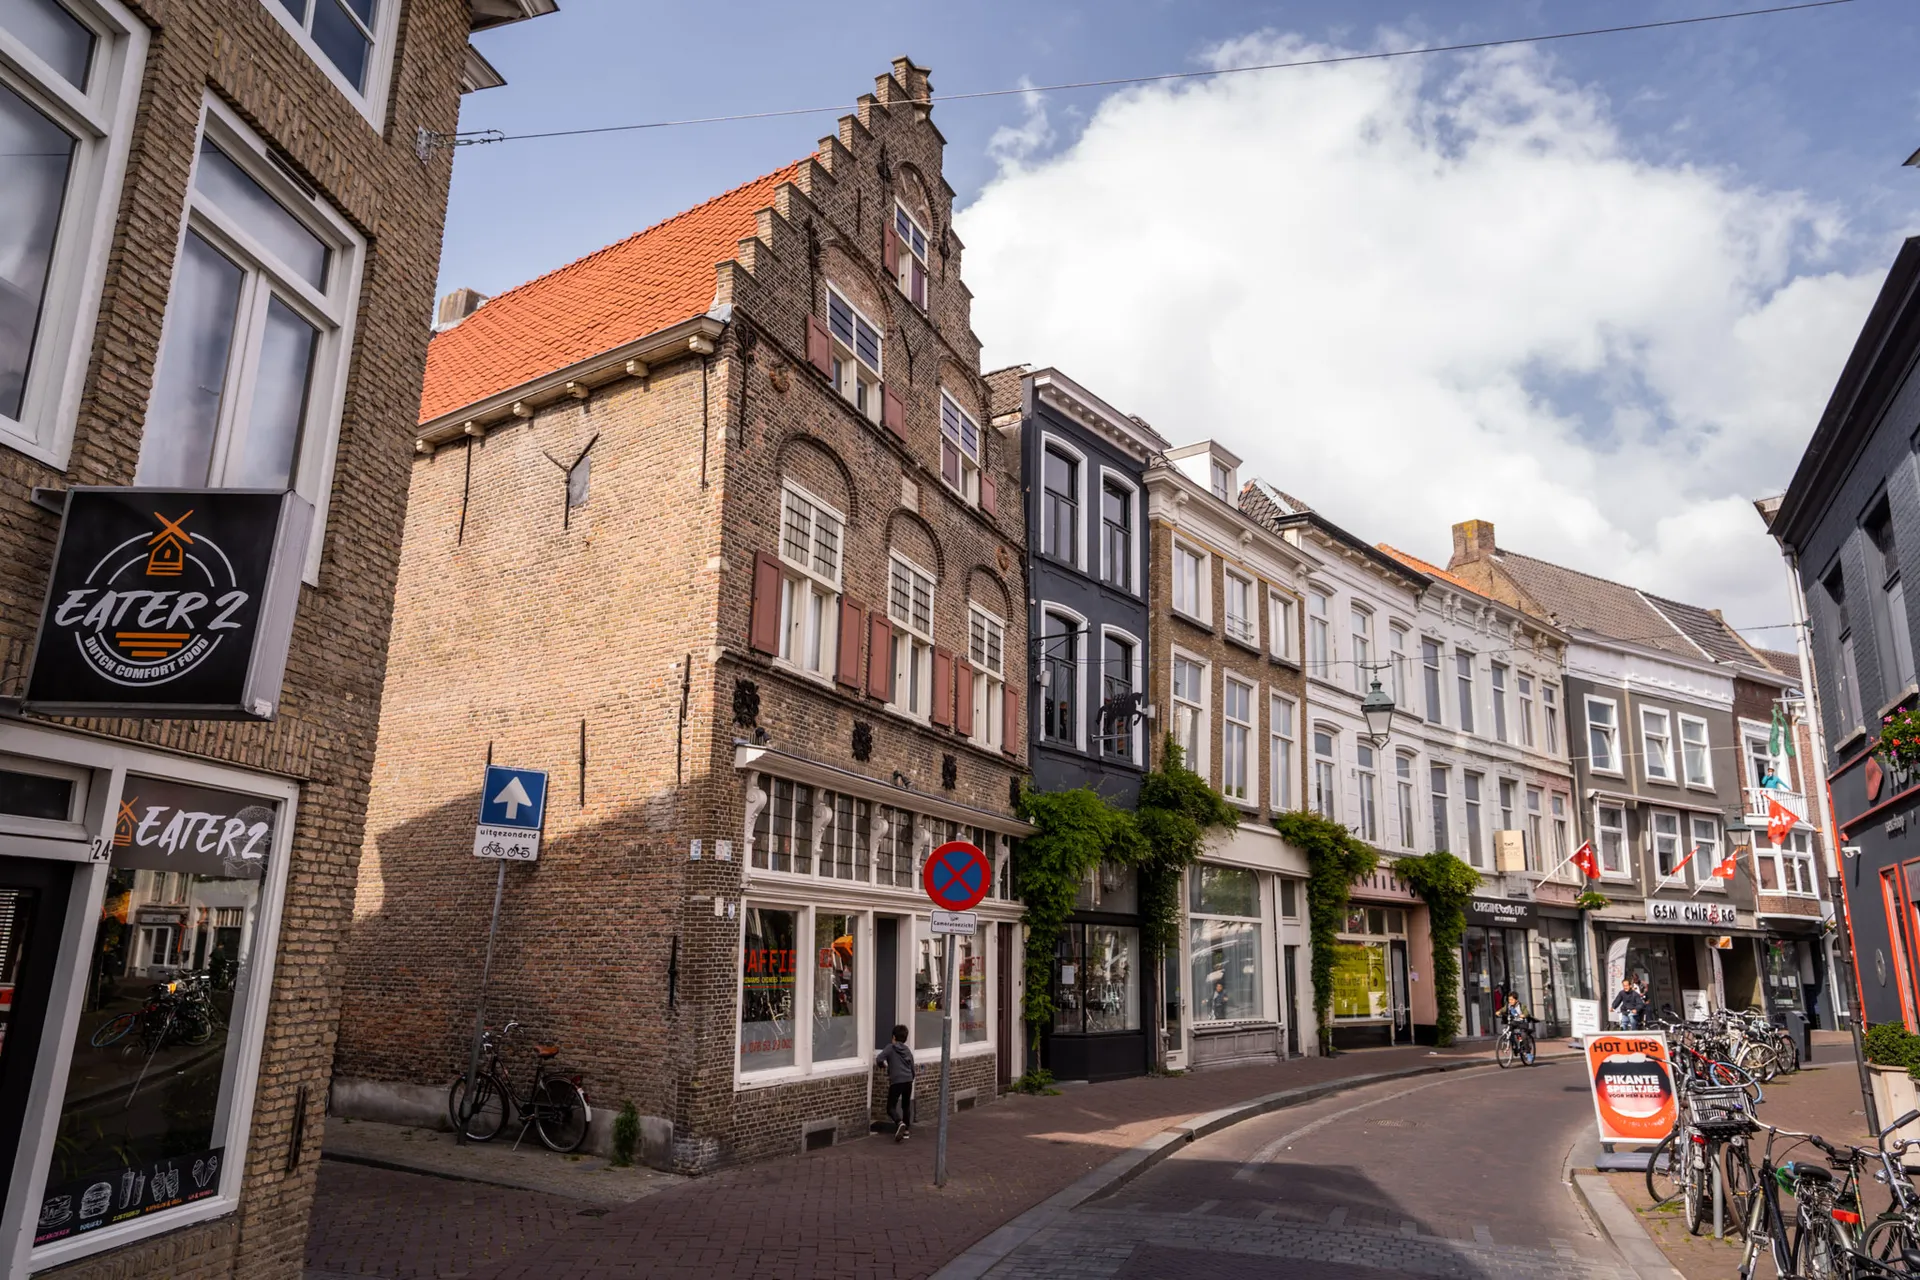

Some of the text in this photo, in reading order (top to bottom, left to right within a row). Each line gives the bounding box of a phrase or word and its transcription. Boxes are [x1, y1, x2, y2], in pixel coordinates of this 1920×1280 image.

[54, 588, 249, 633] EATER 2
[84, 635, 209, 679] DUTCH COMFORT FOOD
[480, 829, 537, 839] uitgezonderd
[93, 839, 111, 860] 24
[1653, 905, 1678, 919] GSM
[1593, 1042, 1659, 1052] HOT LIPS
[1604, 1075, 1659, 1084] PIKANTE
[1606, 1085, 1661, 1093] SPEELTJES
